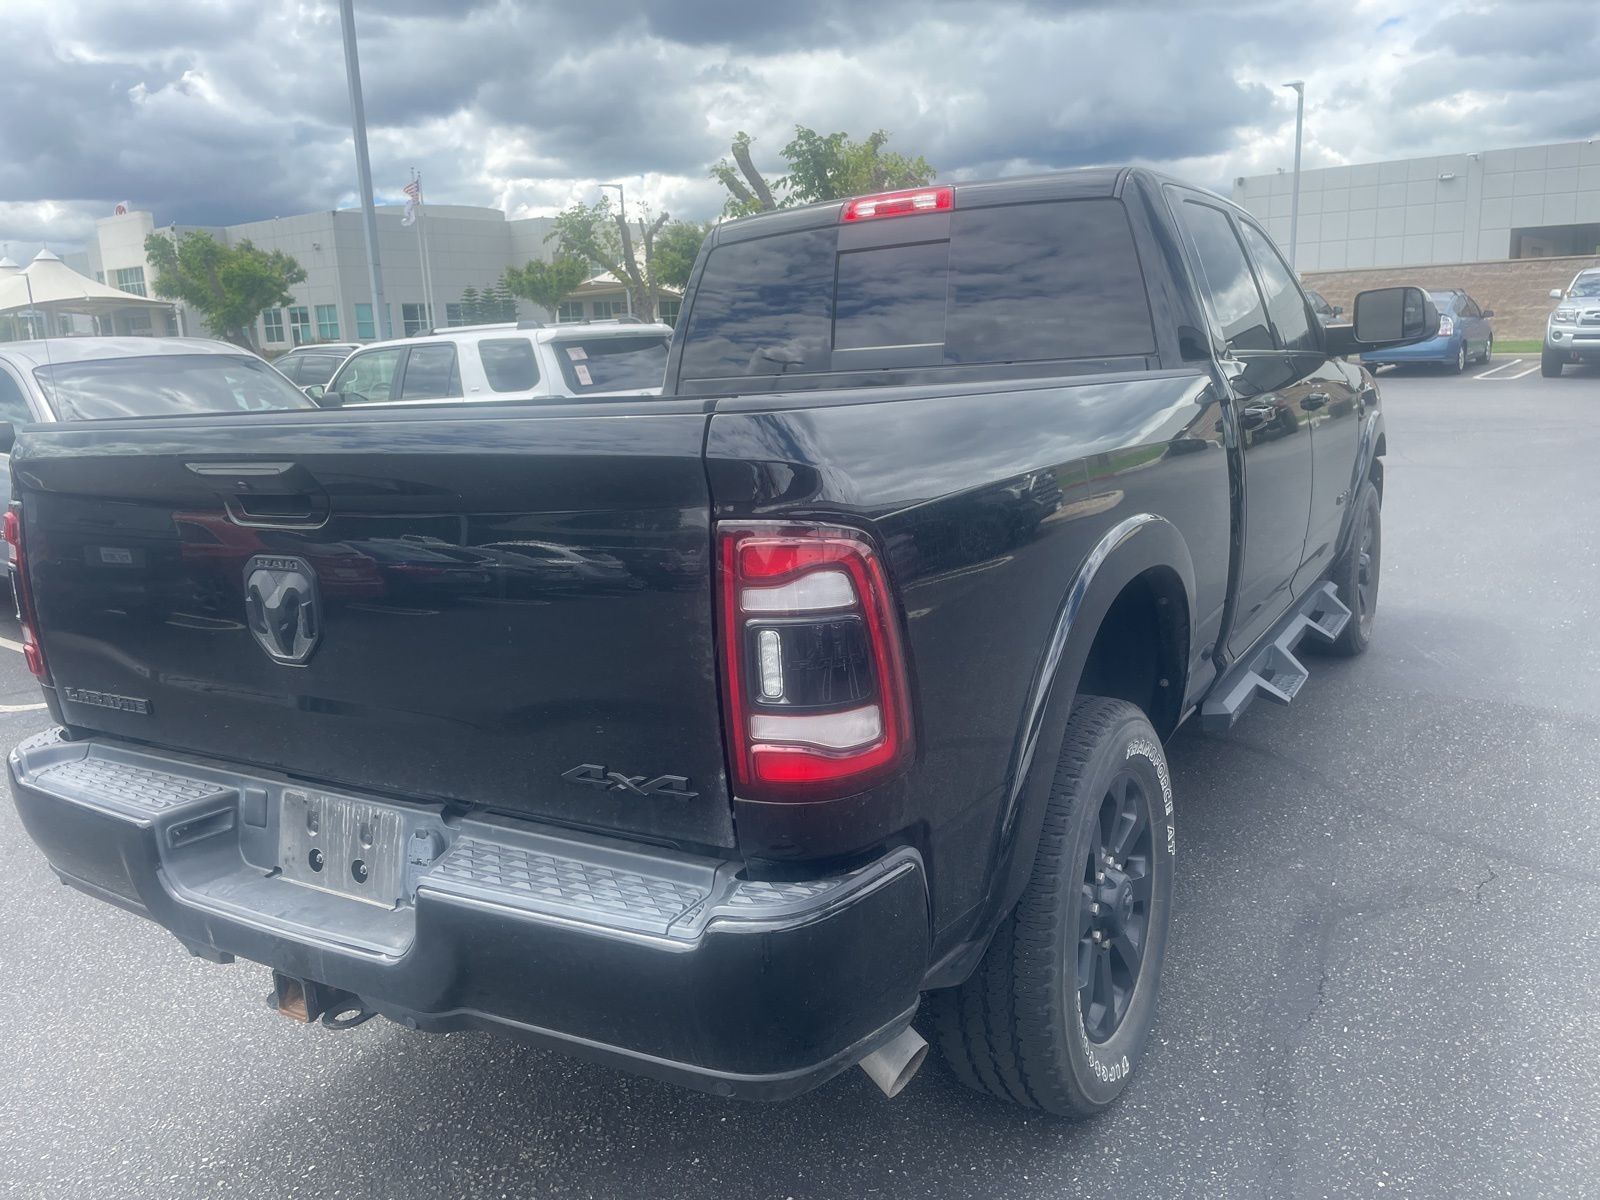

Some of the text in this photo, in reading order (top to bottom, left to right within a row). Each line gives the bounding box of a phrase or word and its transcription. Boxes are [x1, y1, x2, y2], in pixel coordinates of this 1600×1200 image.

[256, 559, 298, 570] RAM
[1125, 738, 1176, 856] TRANSFORCE AT
